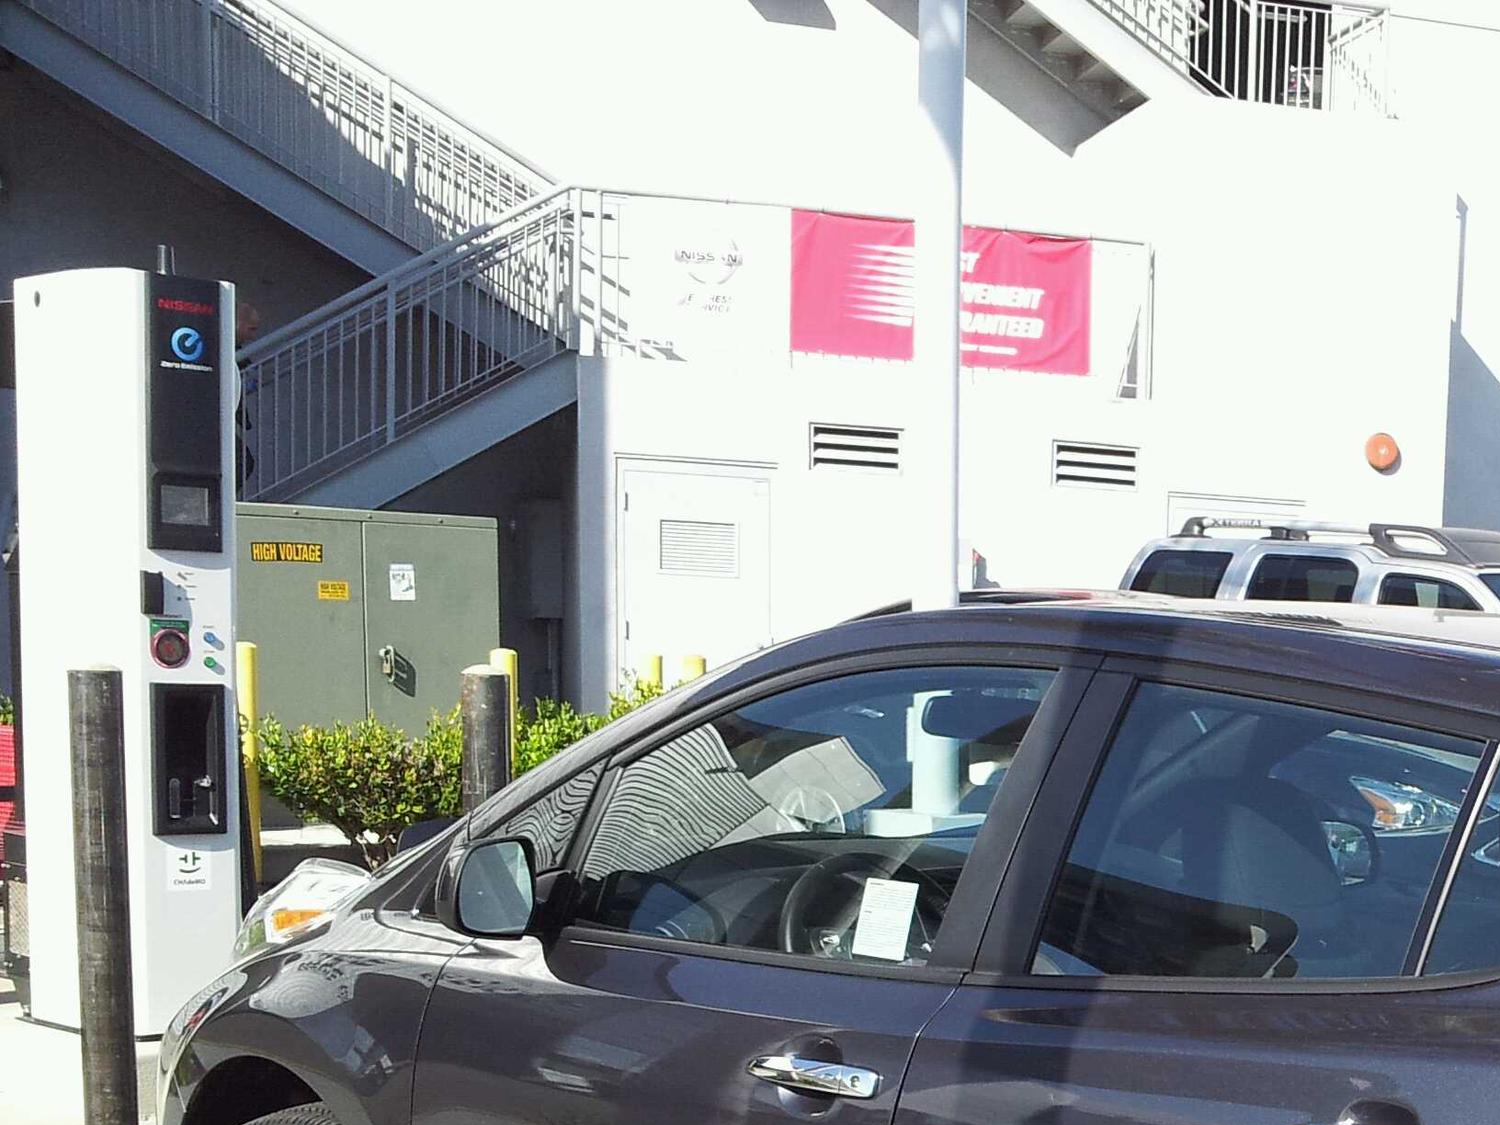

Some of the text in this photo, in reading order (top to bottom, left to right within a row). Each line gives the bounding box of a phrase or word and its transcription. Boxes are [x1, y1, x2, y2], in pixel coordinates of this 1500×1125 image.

[680, 250, 738, 264] NISSN
[157, 298, 214, 315] NISSAN
[252, 543, 322, 562] HIGH VOLTAGE
